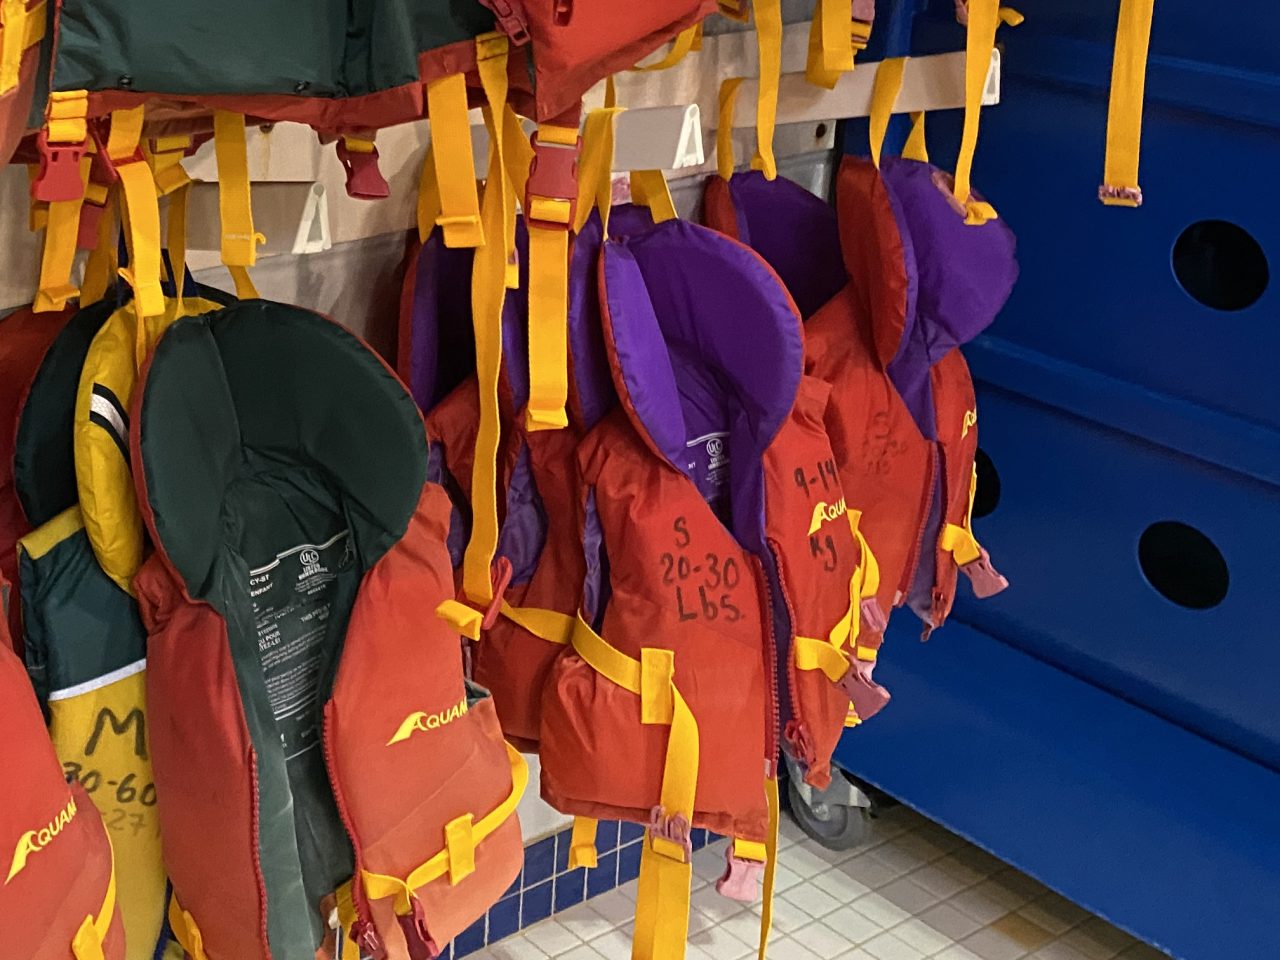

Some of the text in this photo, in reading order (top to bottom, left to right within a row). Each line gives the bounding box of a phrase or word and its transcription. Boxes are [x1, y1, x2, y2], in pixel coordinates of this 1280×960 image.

[674, 515, 690, 549] S
[660, 552, 741, 590] 20-30
[84, 706, 148, 761] M
[63, 761, 157, 807] 30-60
